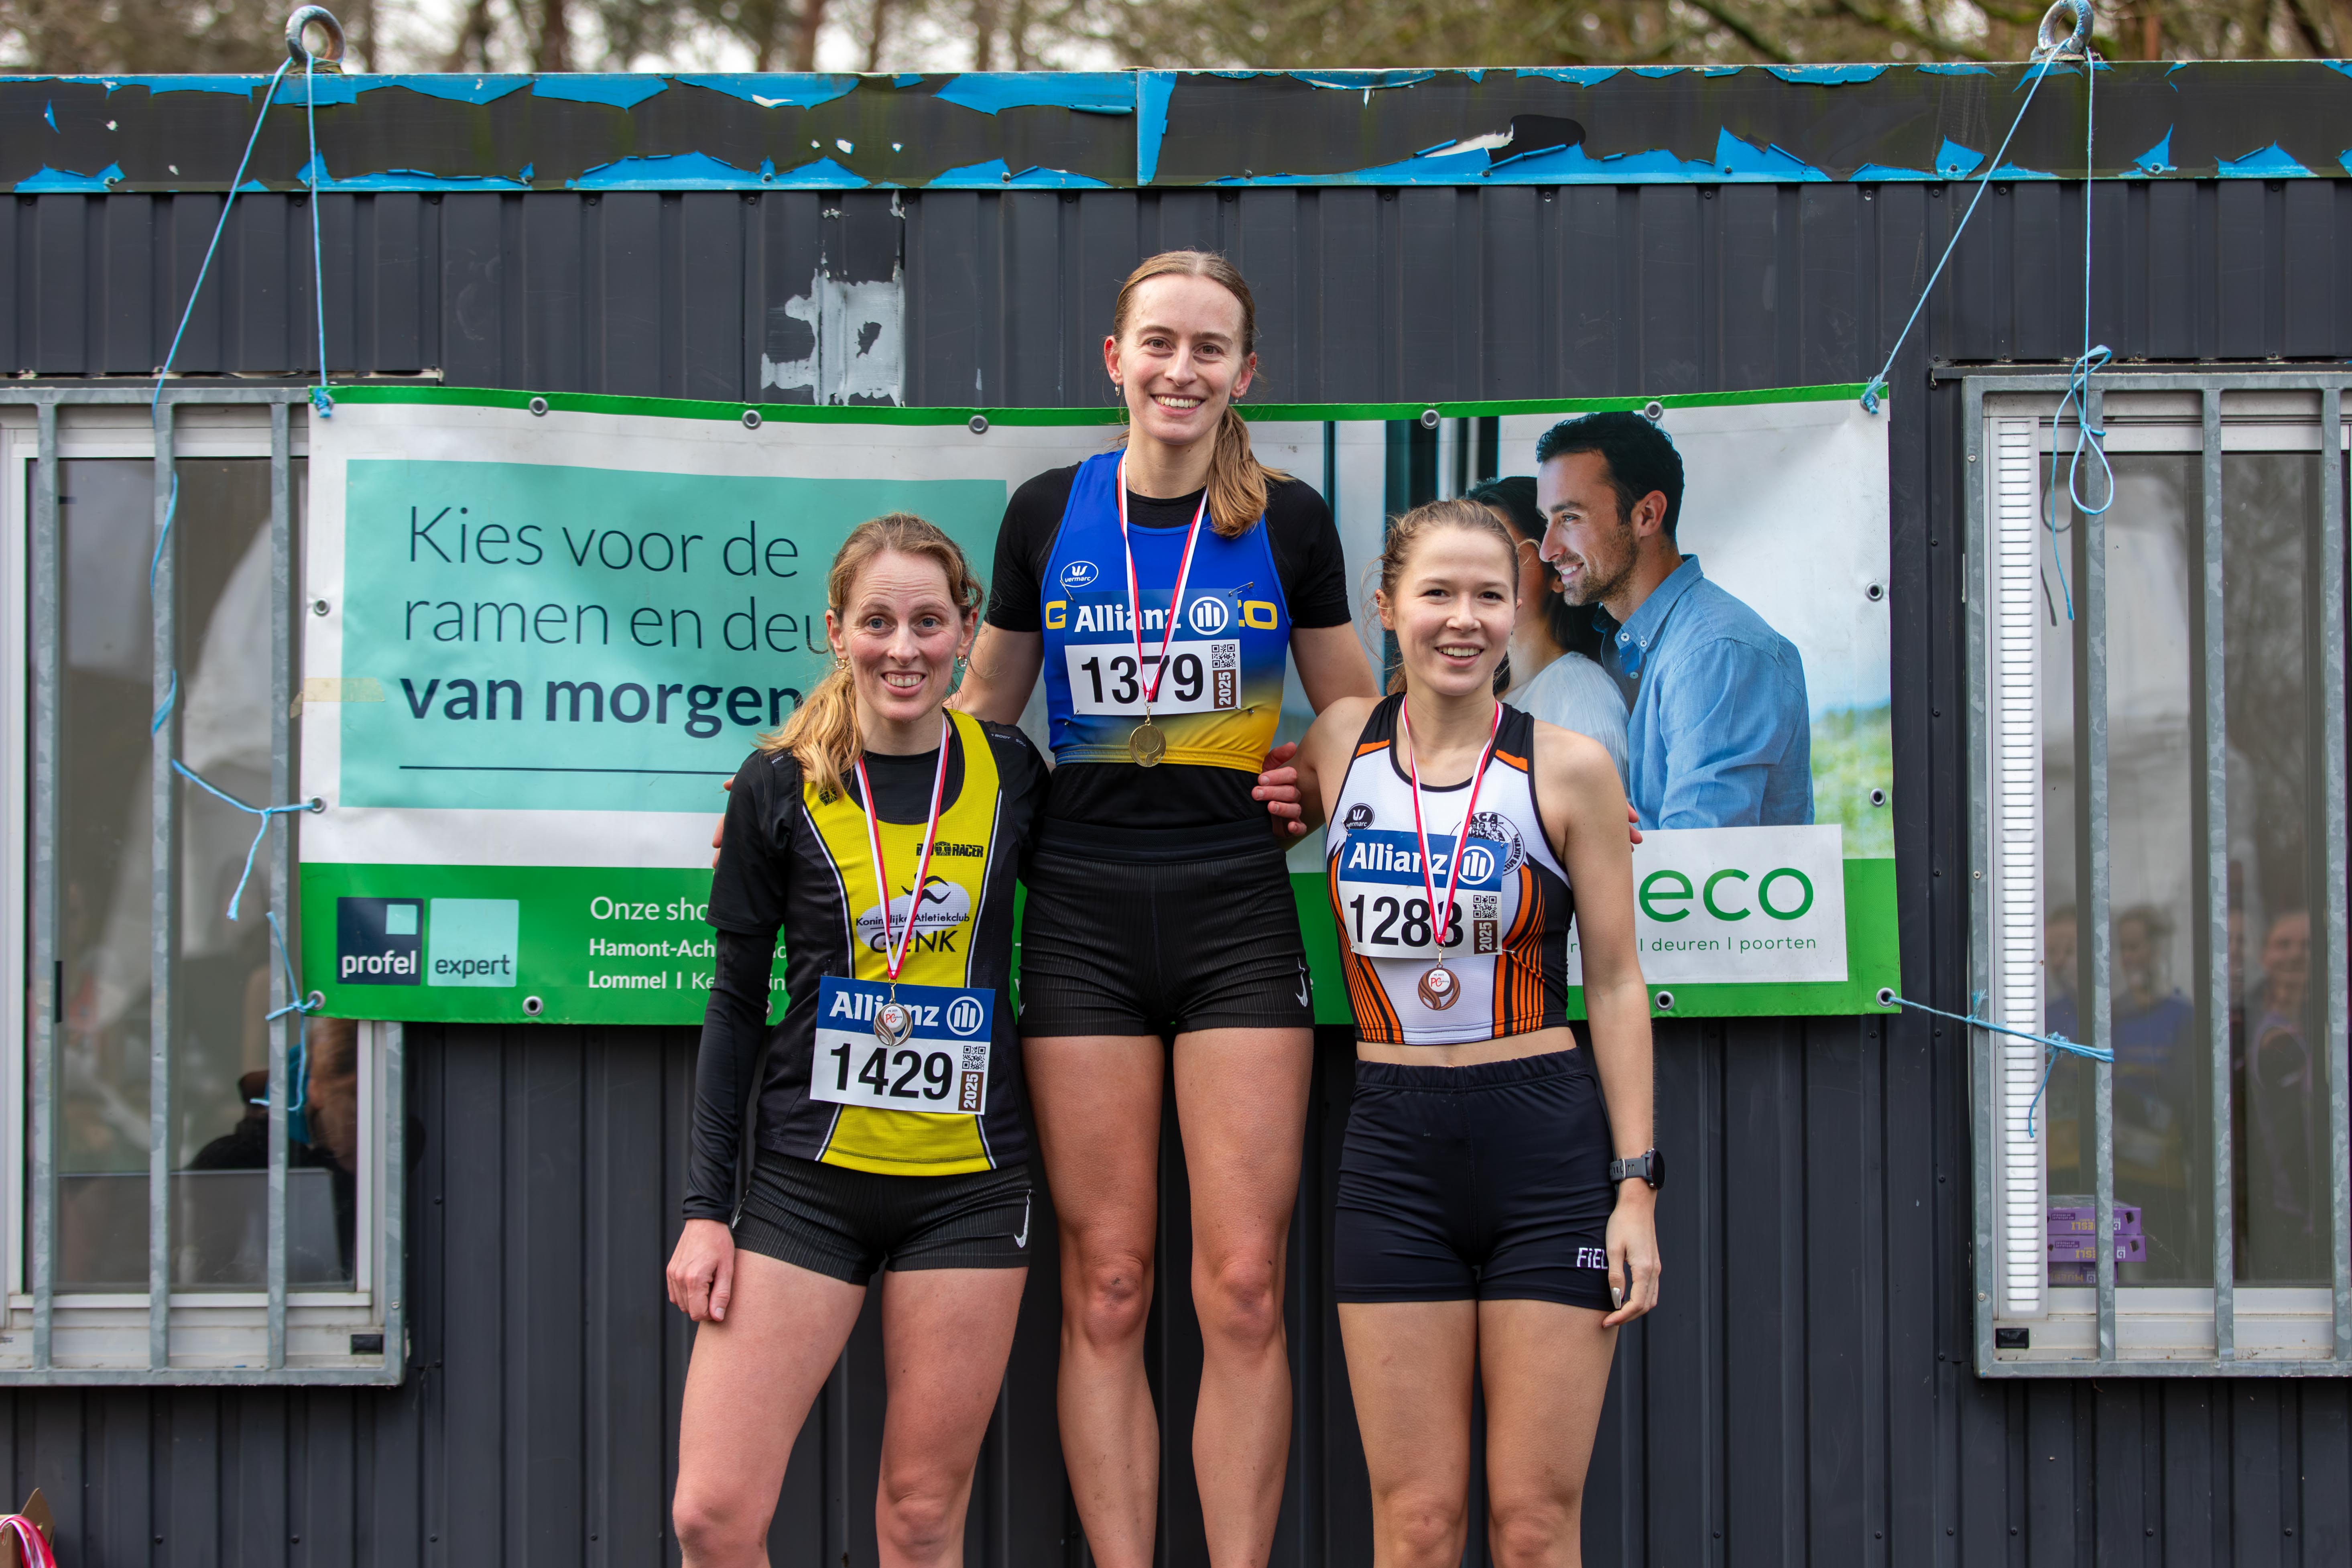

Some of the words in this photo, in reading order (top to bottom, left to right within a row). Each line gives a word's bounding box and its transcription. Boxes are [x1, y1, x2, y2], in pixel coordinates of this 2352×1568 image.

[410, 506, 543, 565] Kies
[562, 527, 703, 573] voor
[723, 521, 798, 577] de
[405, 600, 608, 645] ramen
[630, 607, 702, 649] en
[1081, 653, 1203, 704] 1379
[1218, 671, 1232, 706] 2025
[400, 677, 522, 720] van
[546, 681, 803, 739] morgen
[952, 844, 984, 858] RACER
[590, 896, 660, 921] Onze
[1639, 868, 1813, 923] eco
[856, 914, 907, 926] Koninlijk
[915, 912, 970, 923] Atletiekclub
[1350, 894, 1464, 948] 1283
[1479, 923, 1492, 951] 2025
[1652, 938, 1719, 952] deuren
[1740, 936, 1816, 954] poorten
[342, 950, 416, 978] profel
[435, 954, 510, 978] expert
[589, 971, 666, 989] Lommel
[829, 991, 940, 1027] Allinz
[830, 1043, 953, 1100] 1429
[963, 1074, 979, 1110] 2025
